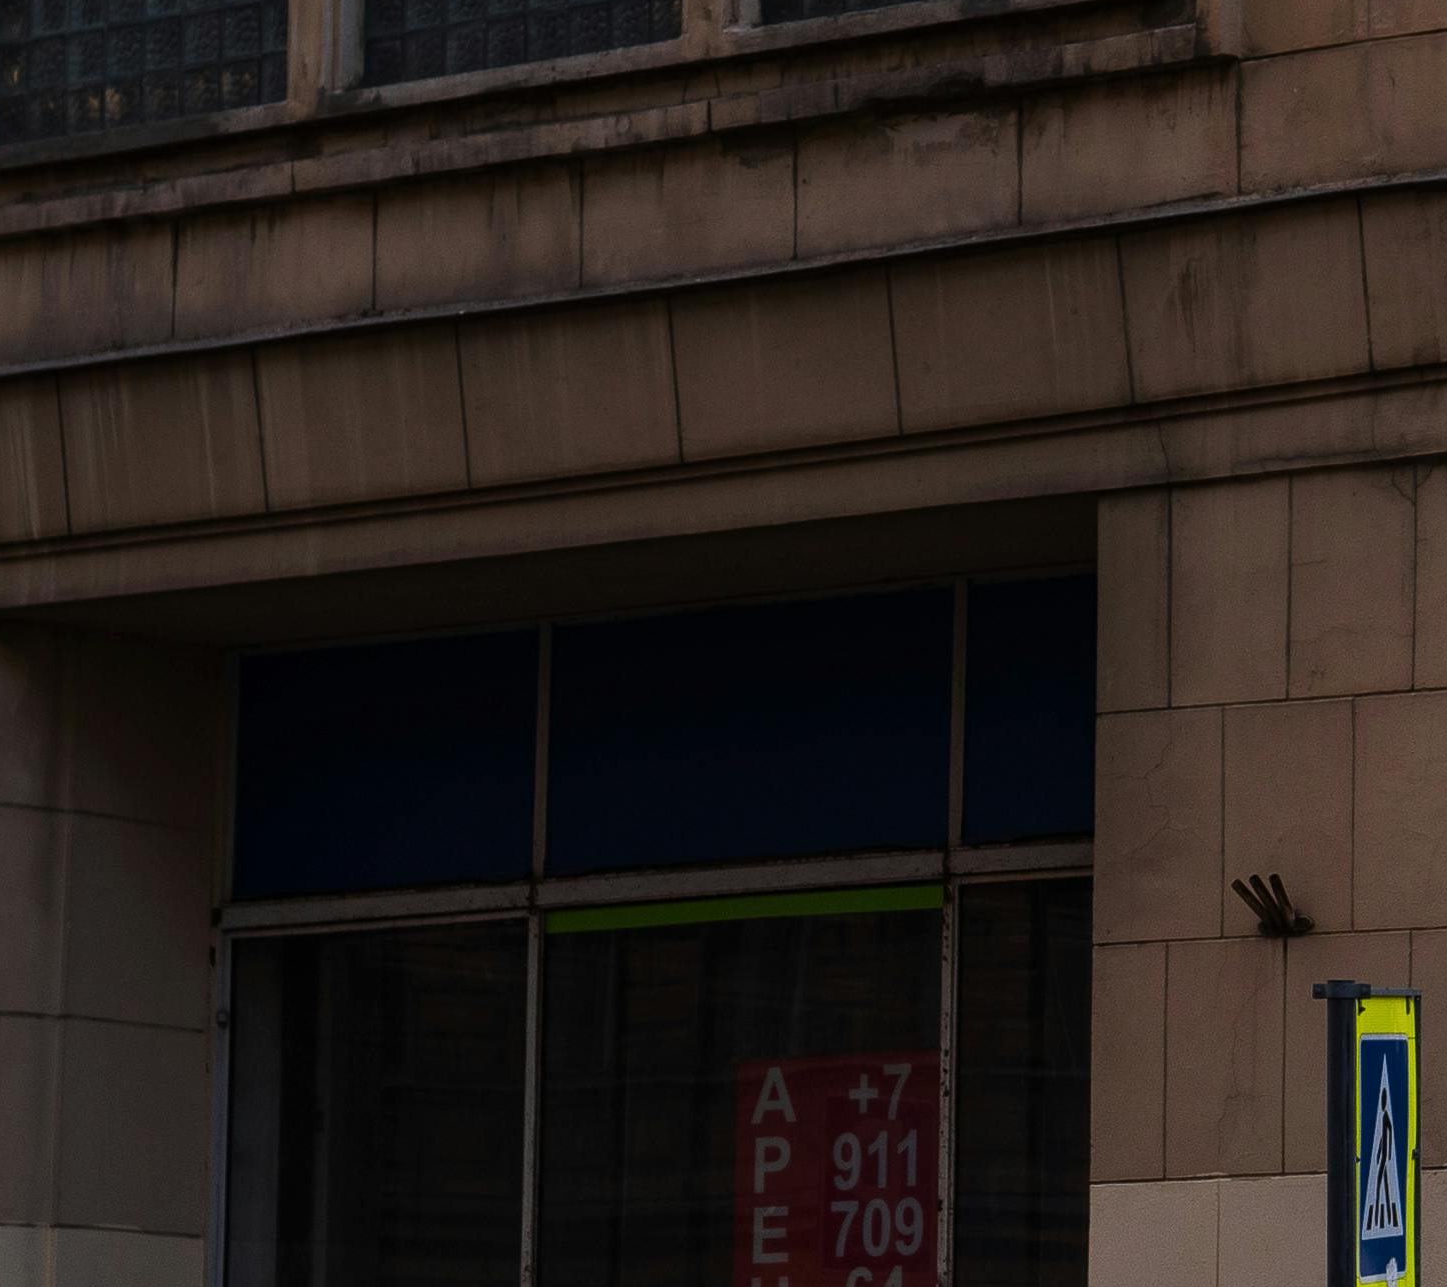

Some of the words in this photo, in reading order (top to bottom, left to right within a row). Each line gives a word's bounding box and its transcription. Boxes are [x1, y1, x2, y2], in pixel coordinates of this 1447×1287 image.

[849, 1063, 913, 1121] +7
[832, 1129, 919, 1192] 911
[830, 1196, 925, 1259] 709
